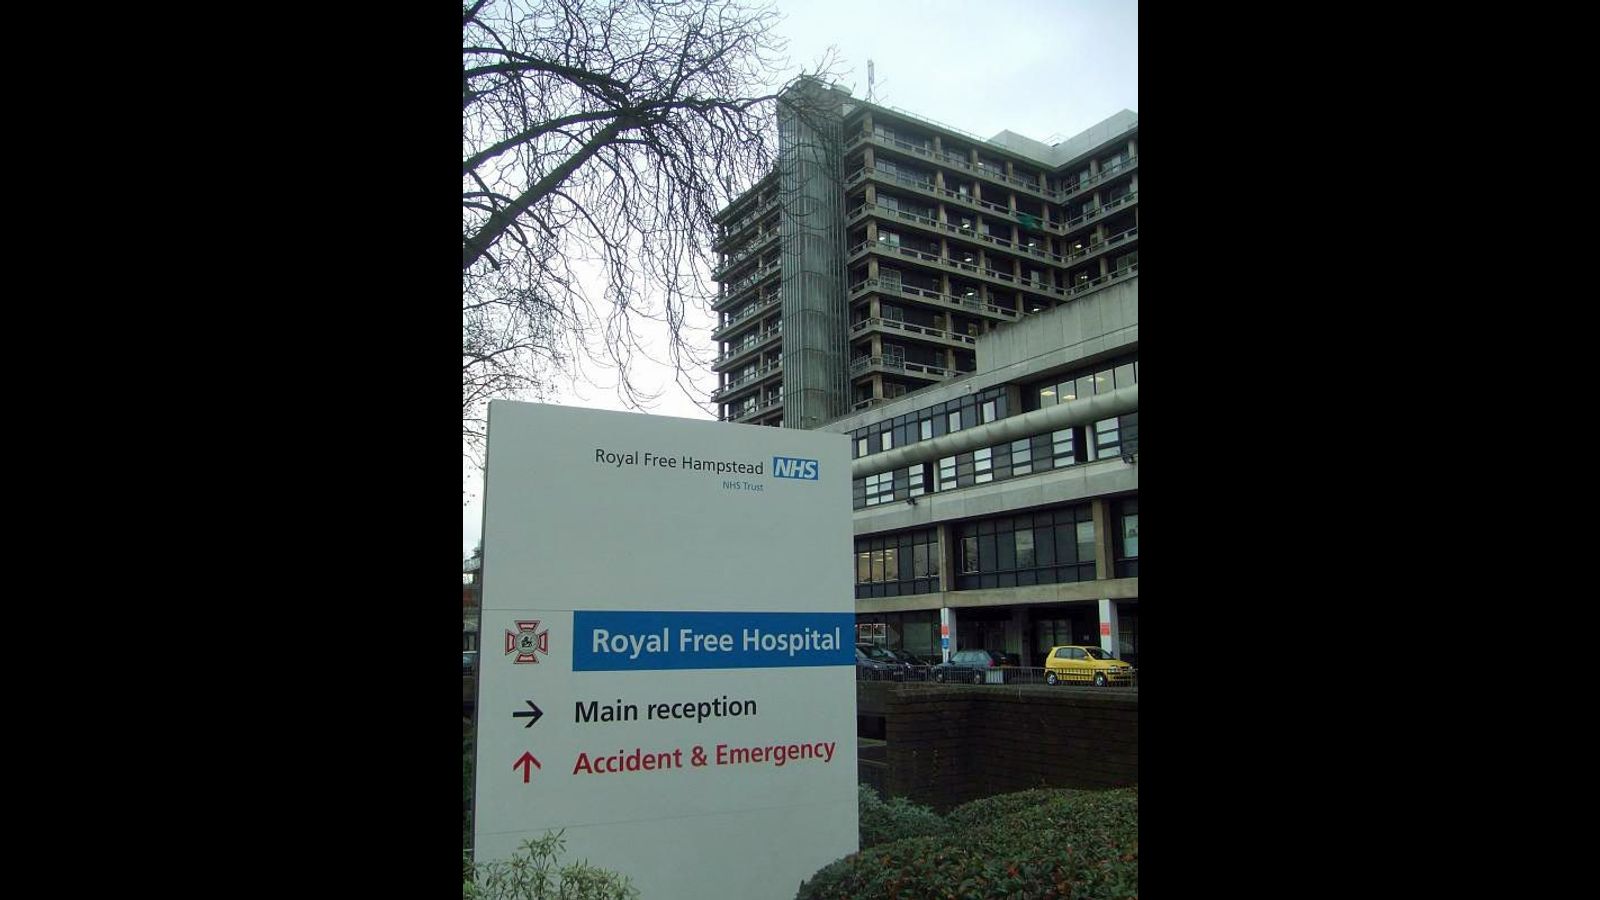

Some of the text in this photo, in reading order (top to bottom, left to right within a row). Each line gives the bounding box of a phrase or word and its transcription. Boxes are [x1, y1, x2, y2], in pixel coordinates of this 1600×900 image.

[596, 448, 817, 479] Royal Free Hampstead NHS
[722, 481, 764, 492] NHS Trust
[592, 627, 841, 660] Royal Free Hospital
[574, 695, 757, 724] Main reception
[573, 741, 836, 775] Accident & Emergency
